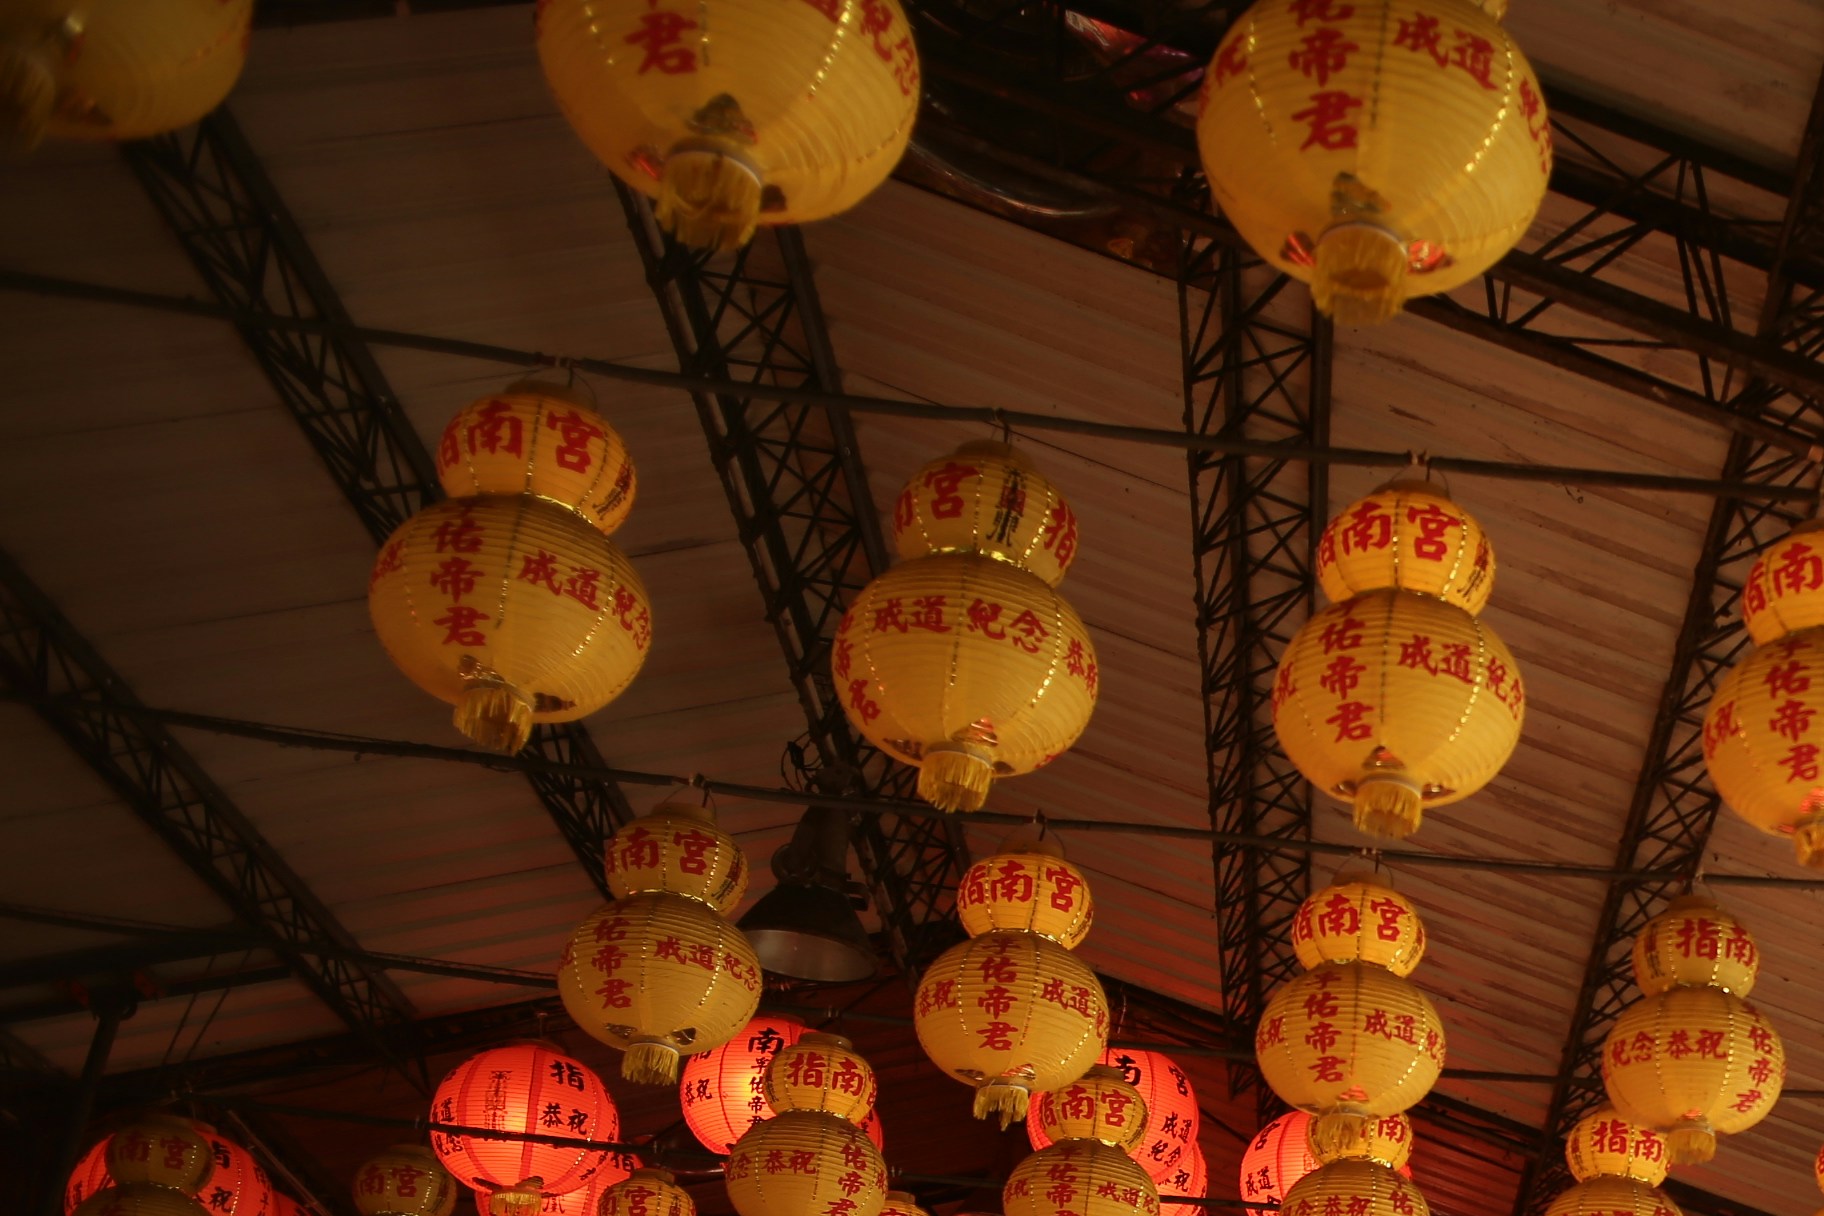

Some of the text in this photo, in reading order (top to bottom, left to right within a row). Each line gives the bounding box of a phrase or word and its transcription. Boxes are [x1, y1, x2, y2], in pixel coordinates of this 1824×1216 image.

[872, 595, 1049, 654] 成道紀念
[959, 863, 1081, 914] 指南宮
[1668, 1030, 1726, 1060] 恭祝
[550, 1059, 585, 1091] 指
[539, 1102, 588, 1135] 恭祝
[763, 1150, 817, 1175] 恭祝
